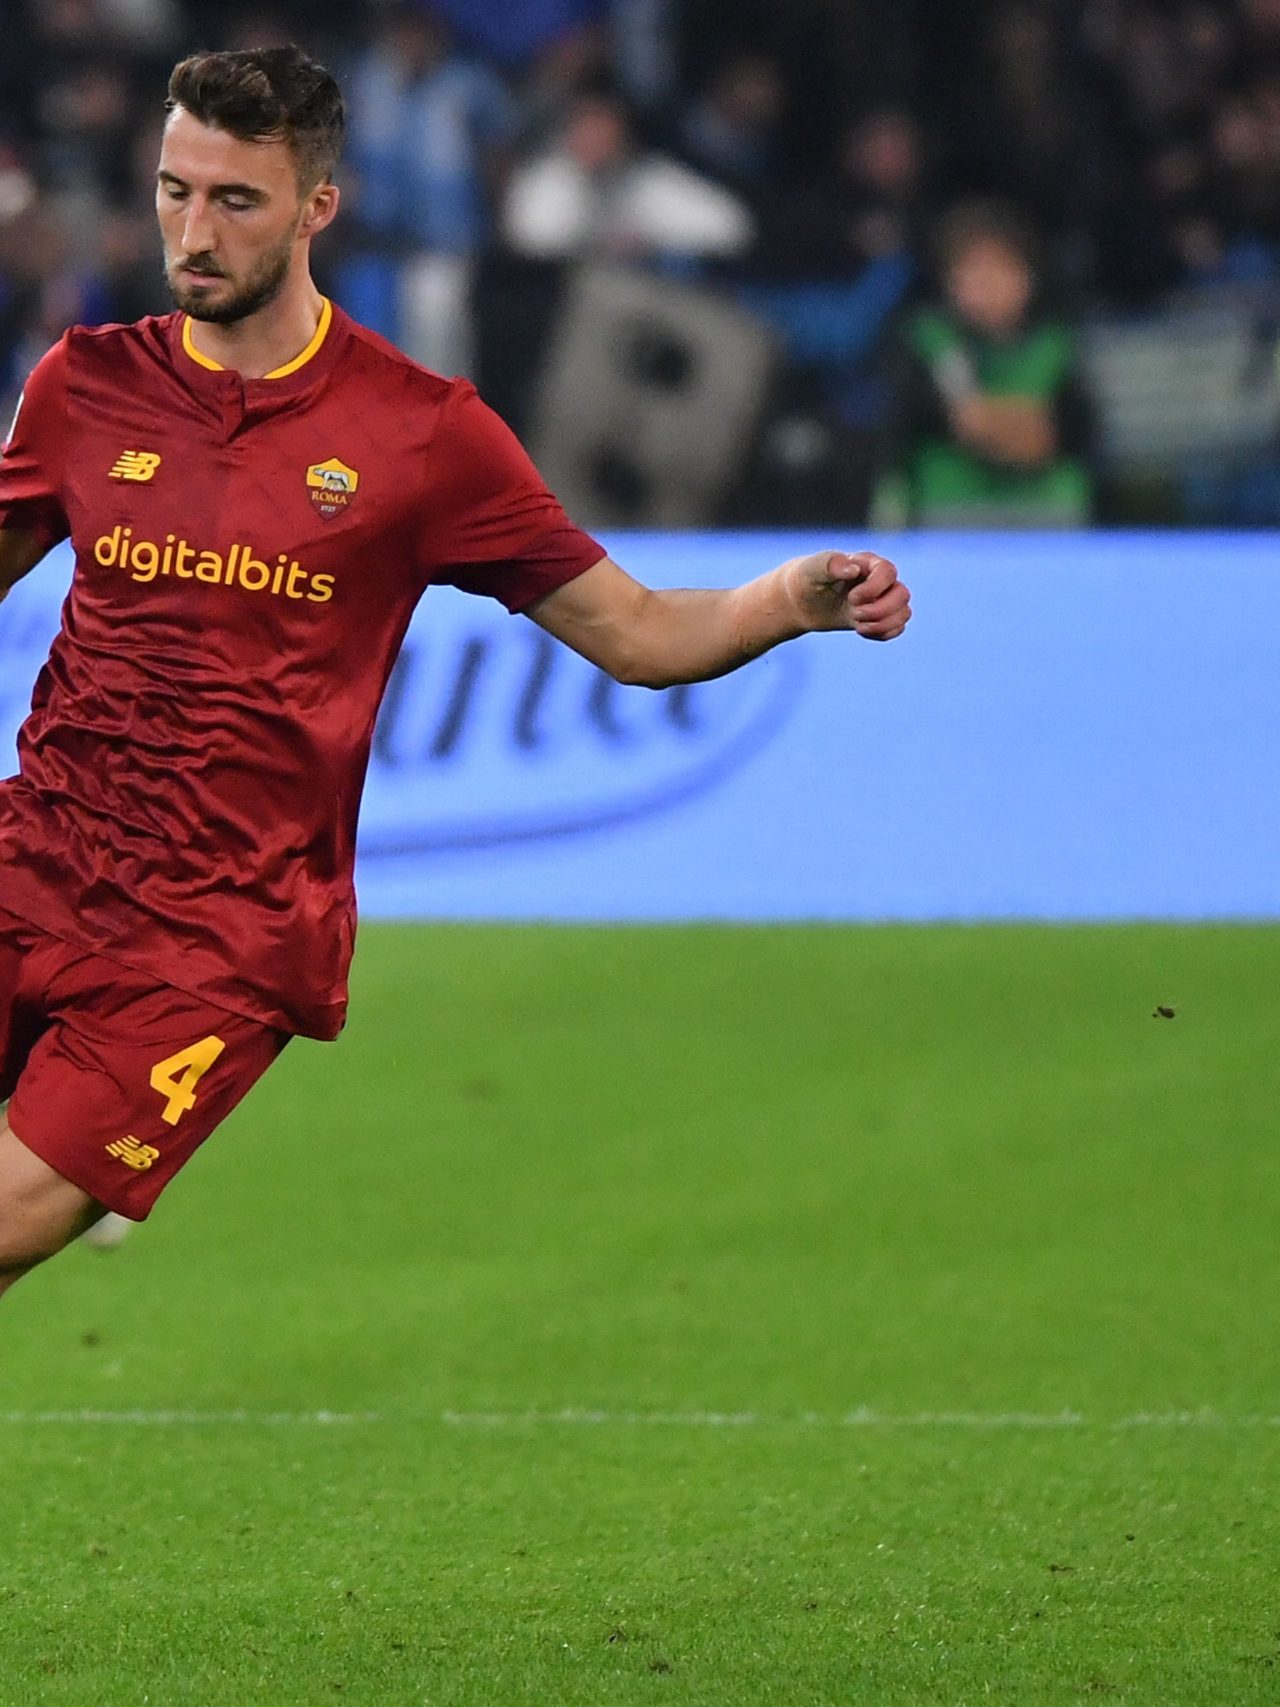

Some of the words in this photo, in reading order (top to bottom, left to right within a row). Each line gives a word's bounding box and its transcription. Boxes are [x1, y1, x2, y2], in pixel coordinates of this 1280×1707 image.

[312, 490, 347, 504] ROMA
[94, 525, 336, 602] digitalbits
[149, 1034, 226, 1127] 4
